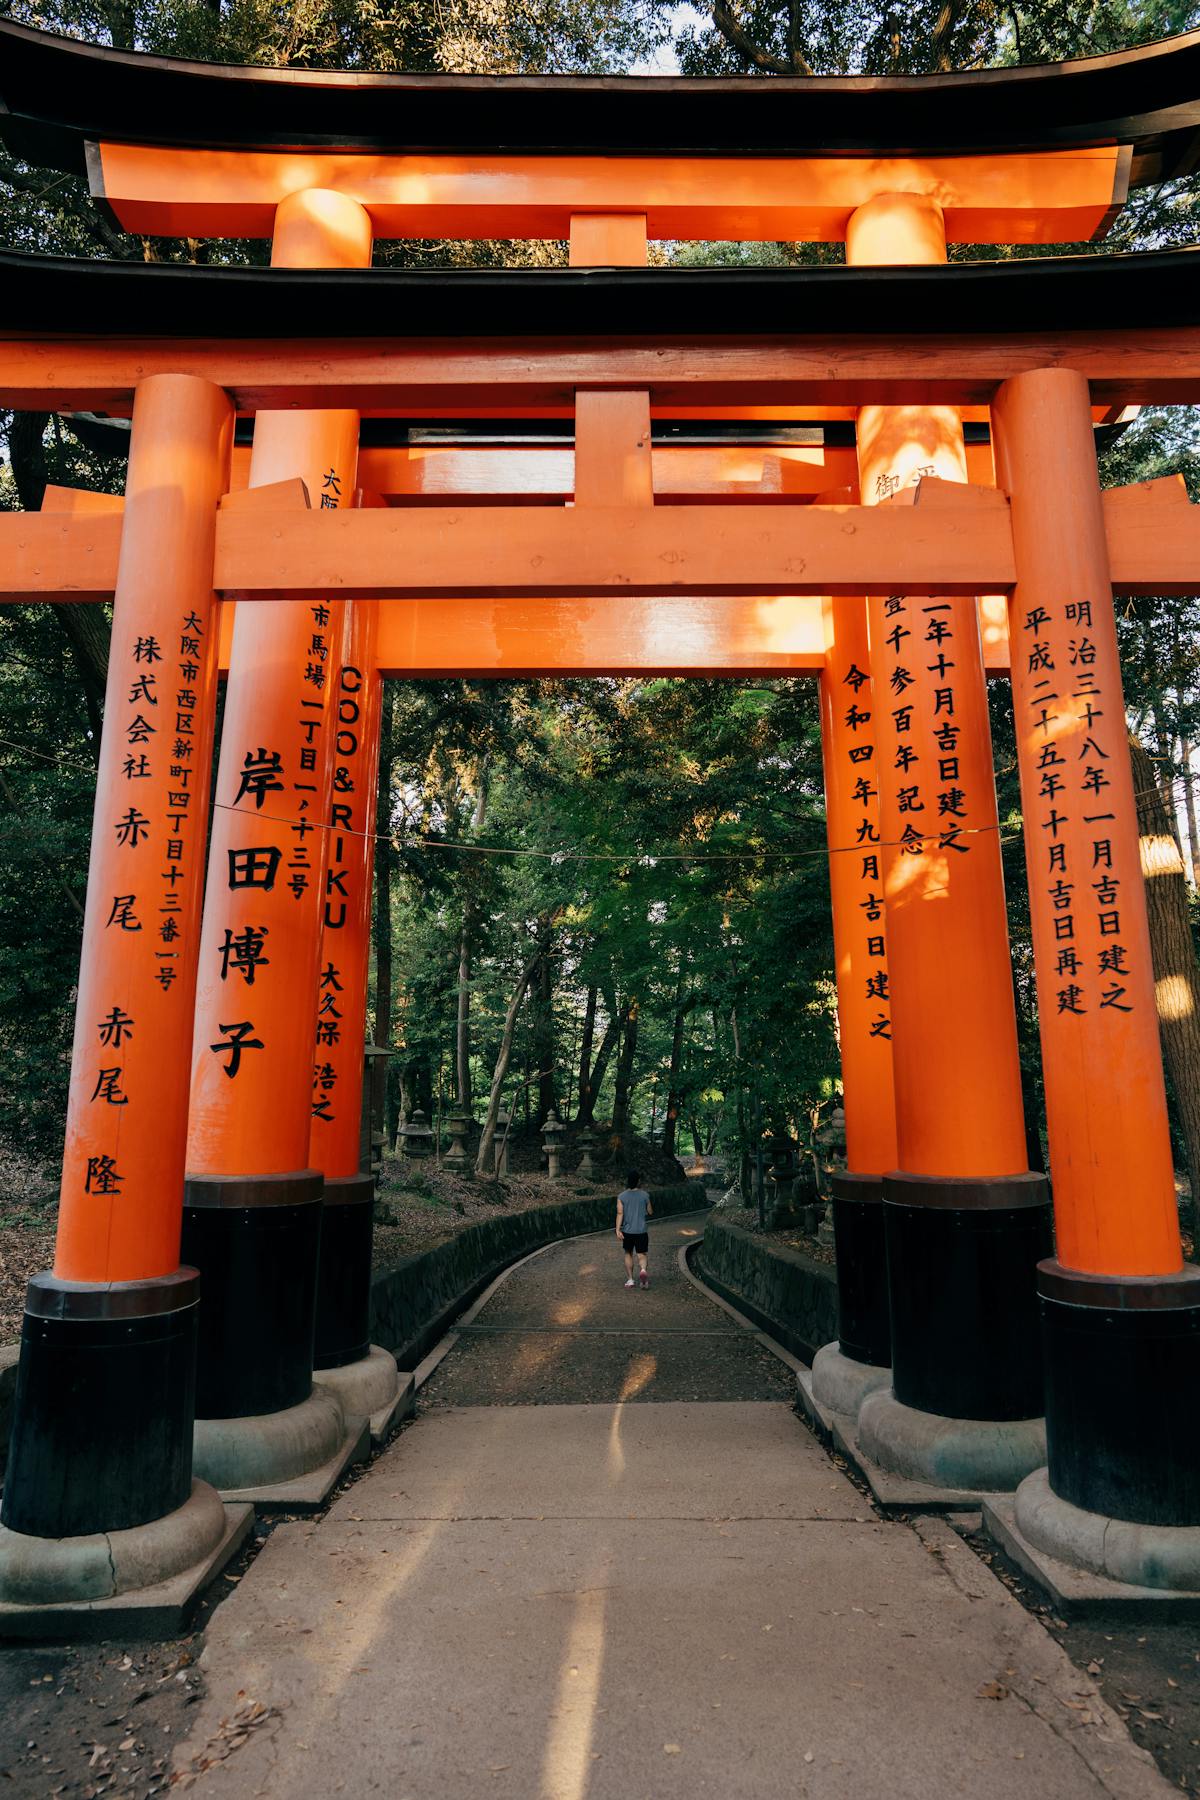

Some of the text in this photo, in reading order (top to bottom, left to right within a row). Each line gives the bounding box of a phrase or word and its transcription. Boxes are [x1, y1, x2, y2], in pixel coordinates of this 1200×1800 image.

[154, 611, 203, 991] 大阪市西区新町四丁目十三番一号
[210, 747, 285, 1079] 岸田博子
[843, 664, 892, 1040] 令和四年九月吉日建之
[1024, 607, 1088, 1015] 平成二十五年十月吉日再建
[1065, 601, 1133, 1012] 明治三十八年一月吉日建之
